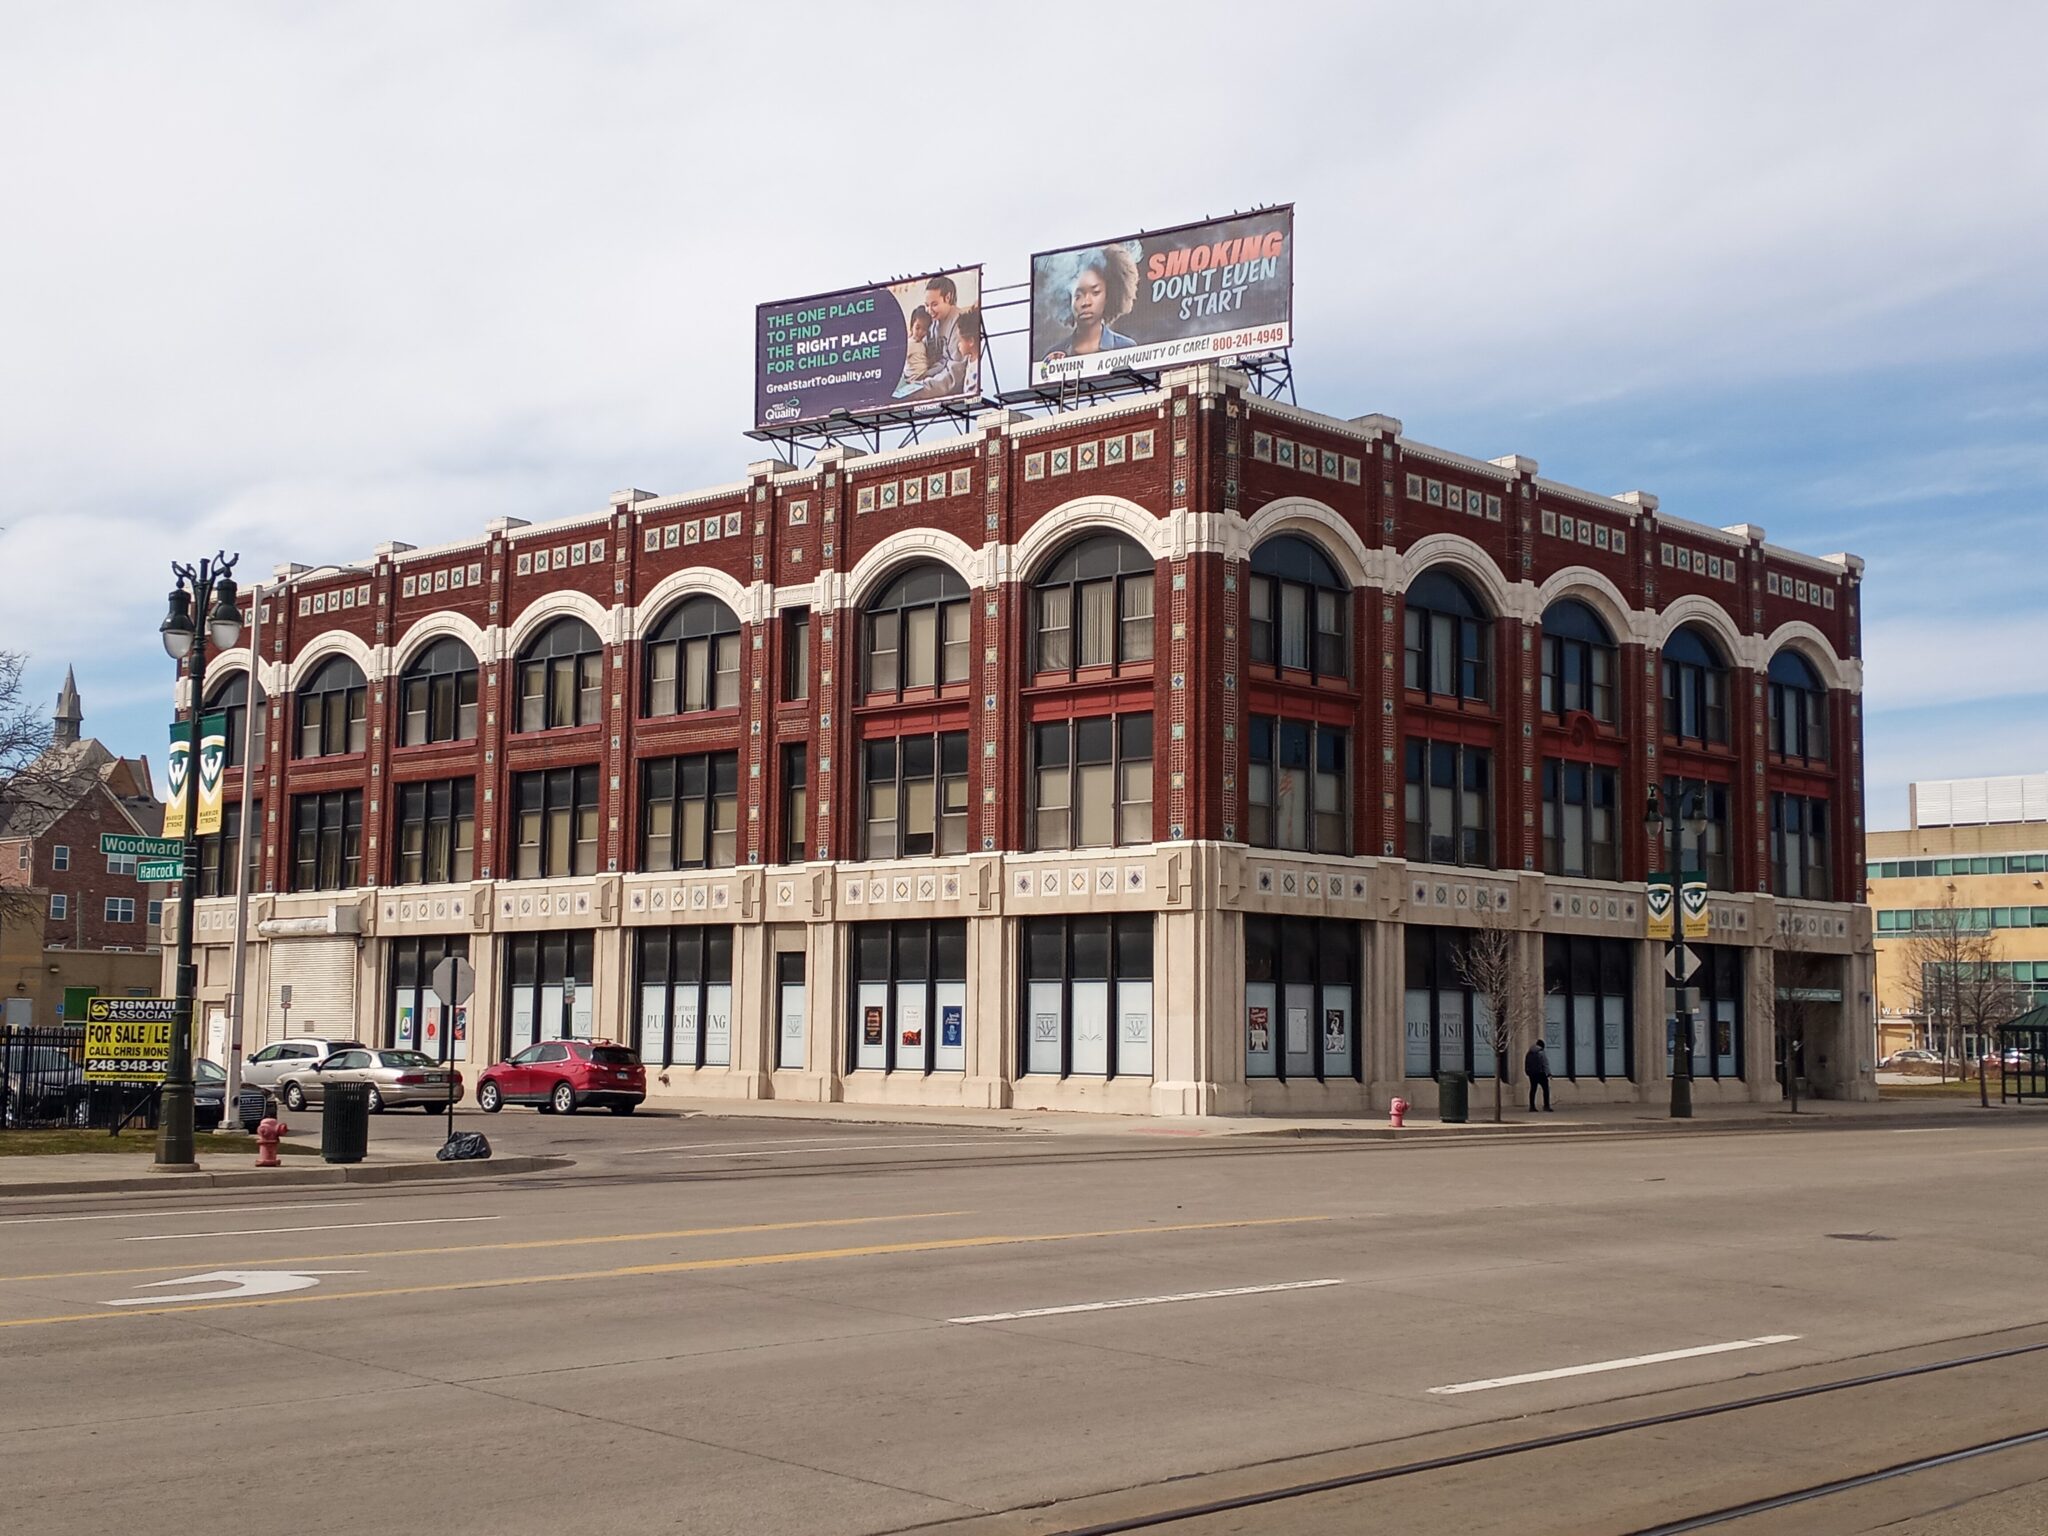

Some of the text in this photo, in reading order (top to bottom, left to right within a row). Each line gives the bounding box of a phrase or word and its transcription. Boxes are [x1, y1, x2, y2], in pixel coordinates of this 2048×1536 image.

[1147, 231, 1283, 280] SMOKING
[1152, 268, 1217, 303] DON'T
[767, 299, 875, 328] THE ONE PLACE
[1179, 285, 1248, 320] START
[767, 324, 821, 344] TO FIND
[767, 328, 887, 359] THE RIGHT PLACE
[1212, 327, 1283, 352] 800-241-4949
[766, 345, 880, 375] FOR CHILD CARE
[1048, 337, 1210, 374] DWIHN A COMMUNITY OF CARE!
[766, 368, 882, 394] GreatStartToQuality.org
[765, 407, 801, 421] Quality
[104, 837, 180, 855] Woodward
[140, 864, 174, 878] Hancock
[108, 1011, 172, 1019] ASSOCIAT
[88, 1025, 112, 1043] FOR
[115, 1025, 145, 1043] SALE
[88, 1046, 169, 1057] CALL CHRIS MONS
[88, 1060, 168, 1072] 248-948-90
